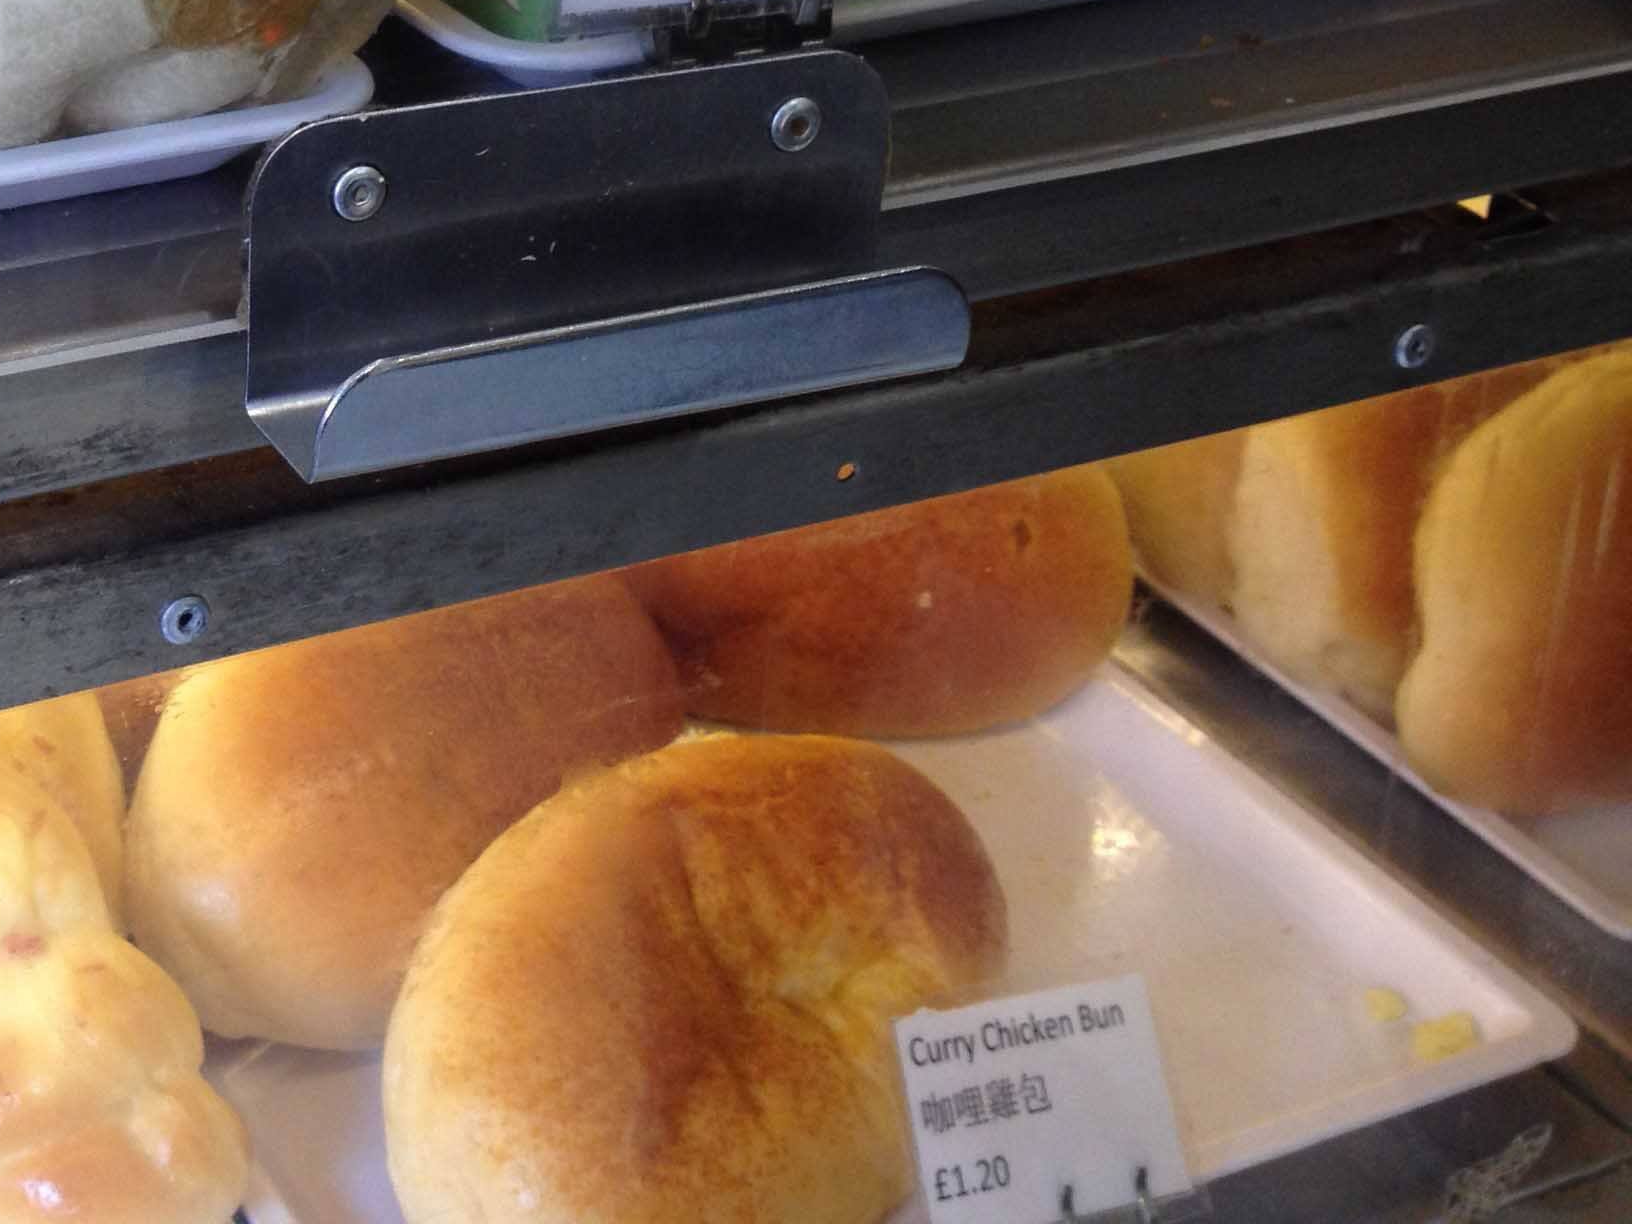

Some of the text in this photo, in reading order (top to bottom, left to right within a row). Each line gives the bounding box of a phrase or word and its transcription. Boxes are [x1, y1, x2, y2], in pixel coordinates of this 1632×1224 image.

[909, 1003, 1125, 1067] Curry Chicken Bun
[920, 1074, 1053, 1134] 咖哩雞包
[934, 1155, 1011, 1201] £1.20
